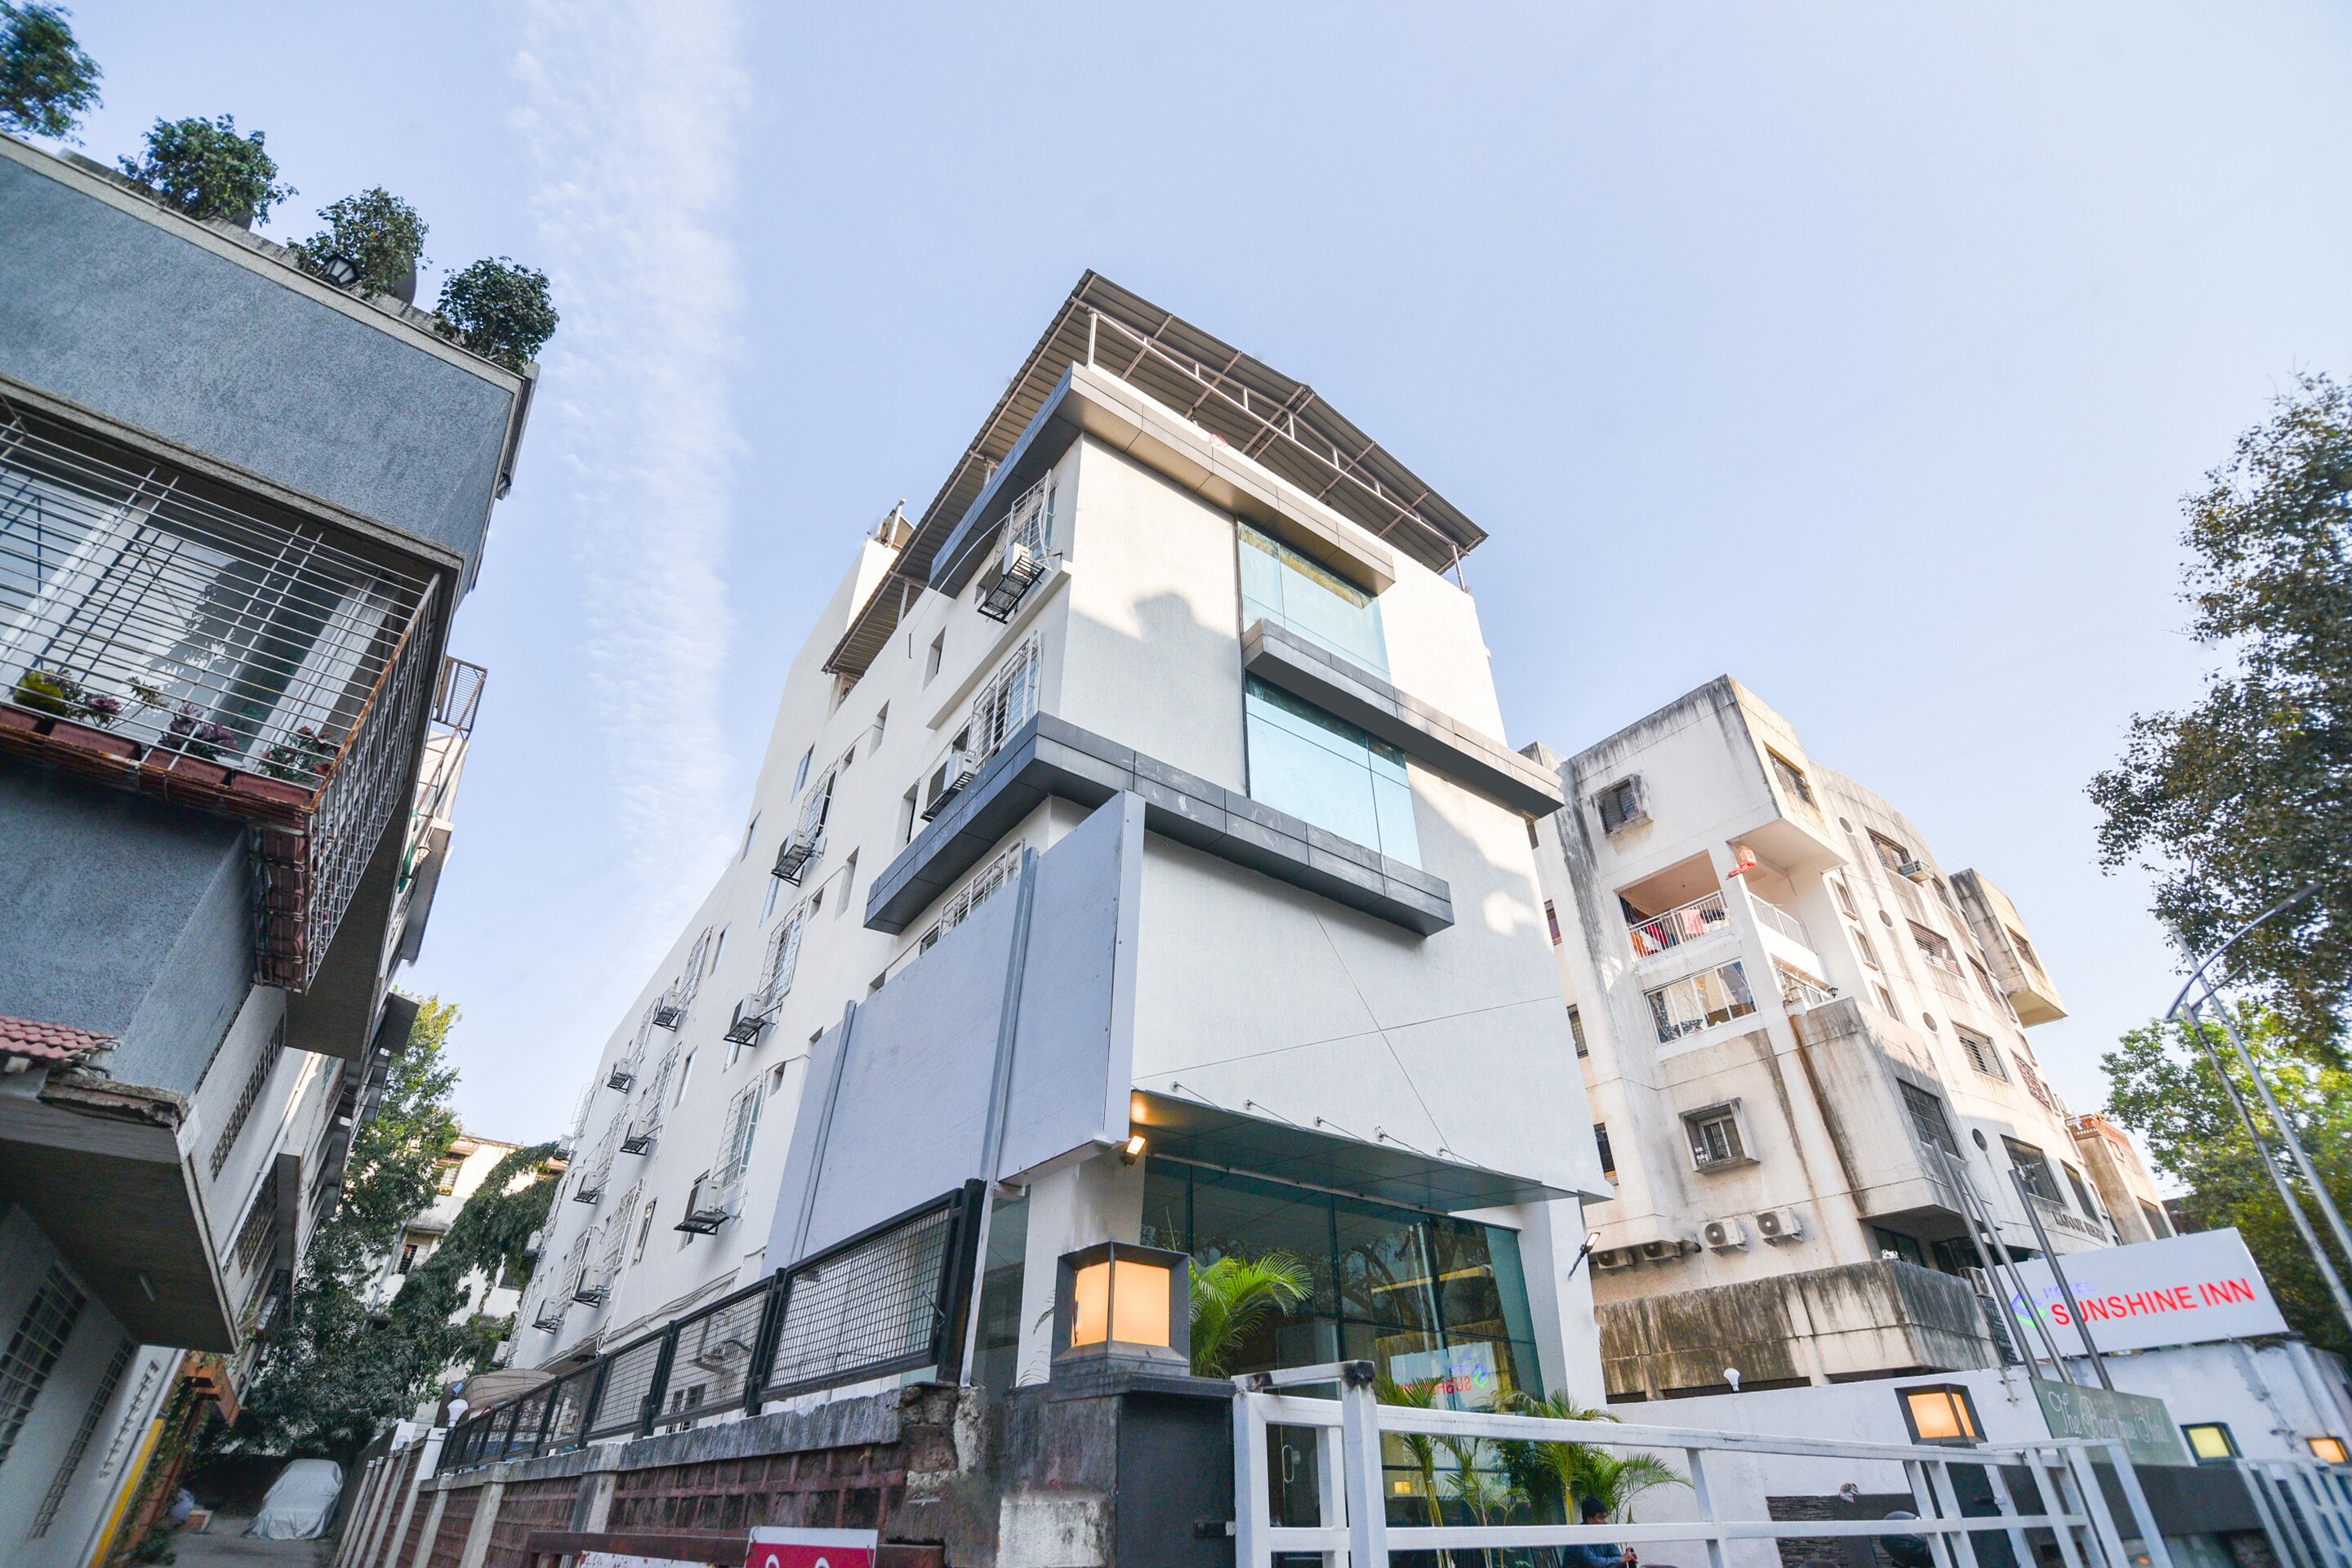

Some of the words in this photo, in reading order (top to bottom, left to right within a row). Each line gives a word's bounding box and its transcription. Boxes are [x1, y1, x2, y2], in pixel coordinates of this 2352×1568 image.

[2042, 1281, 2098, 1299] HOEL
[2051, 1285, 2198, 1325] SUNSHINE
[2198, 1277, 2256, 1307] INN
[2048, 1391, 2082, 1434] The
